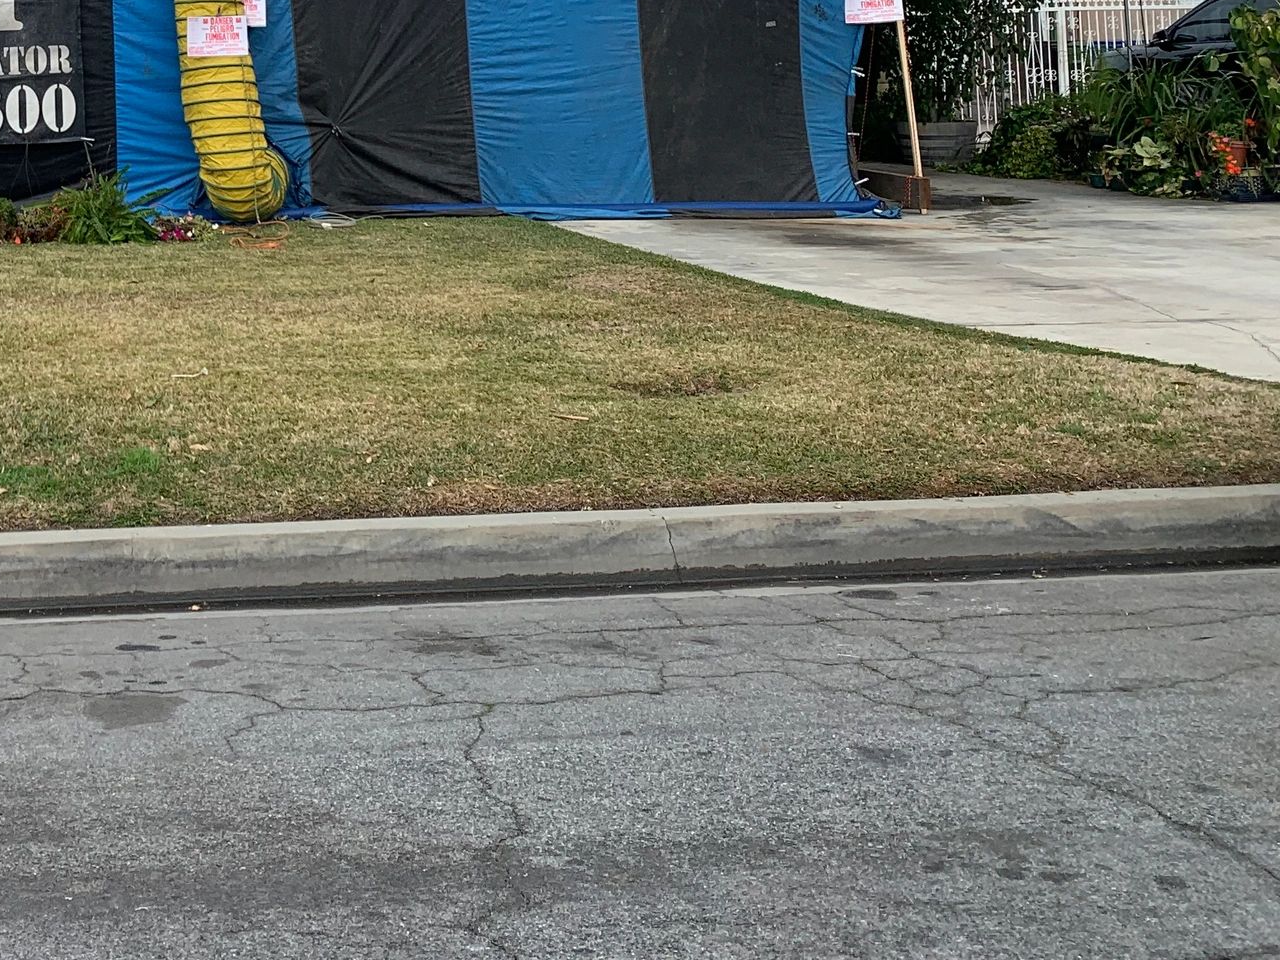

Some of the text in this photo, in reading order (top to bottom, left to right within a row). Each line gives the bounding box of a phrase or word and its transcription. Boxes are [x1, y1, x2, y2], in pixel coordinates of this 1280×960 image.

[861, 0, 894, 8] FUMIGATION
[210, 17, 233, 25] DANGER
[210, 25, 234, 33] PELIGRO
[206, 33, 239, 41] FUMIGATION
